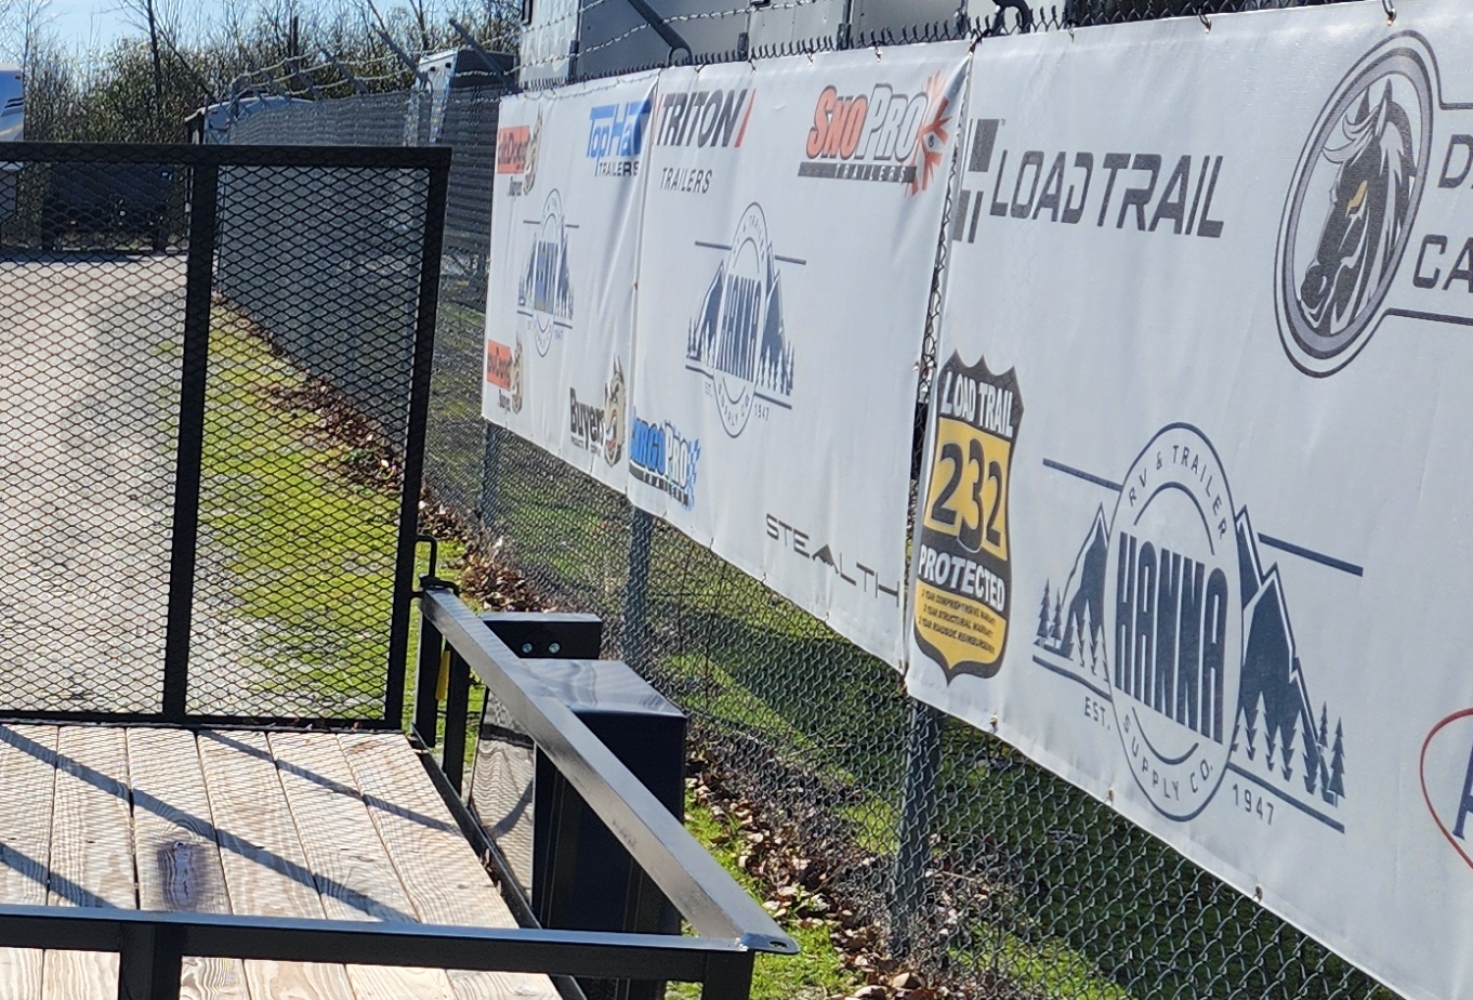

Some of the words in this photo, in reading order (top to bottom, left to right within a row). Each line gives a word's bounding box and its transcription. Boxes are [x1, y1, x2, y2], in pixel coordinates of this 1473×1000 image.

[656, 88, 749, 149] TRITON
[598, 160, 640, 178] TRAILERS
[660, 167, 713, 194] TRAILERS
[940, 370, 977, 422] LOAD
[978, 381, 1014, 438] TRAIL
[930, 437, 1004, 552] 232
[1129, 467, 1147, 507] RV
[1172, 444, 1227, 540] TRAILER
[766, 512, 900, 608] STEALTH
[918, 544, 1006, 612] PROTECTED
[1115, 530, 1229, 745] HANNA
[1084, 696, 1111, 731] EST.
[1123, 714, 1180, 801] SUPPLY
[1190, 759, 1214, 794] CO.
[1232, 783, 1275, 826] 1947
